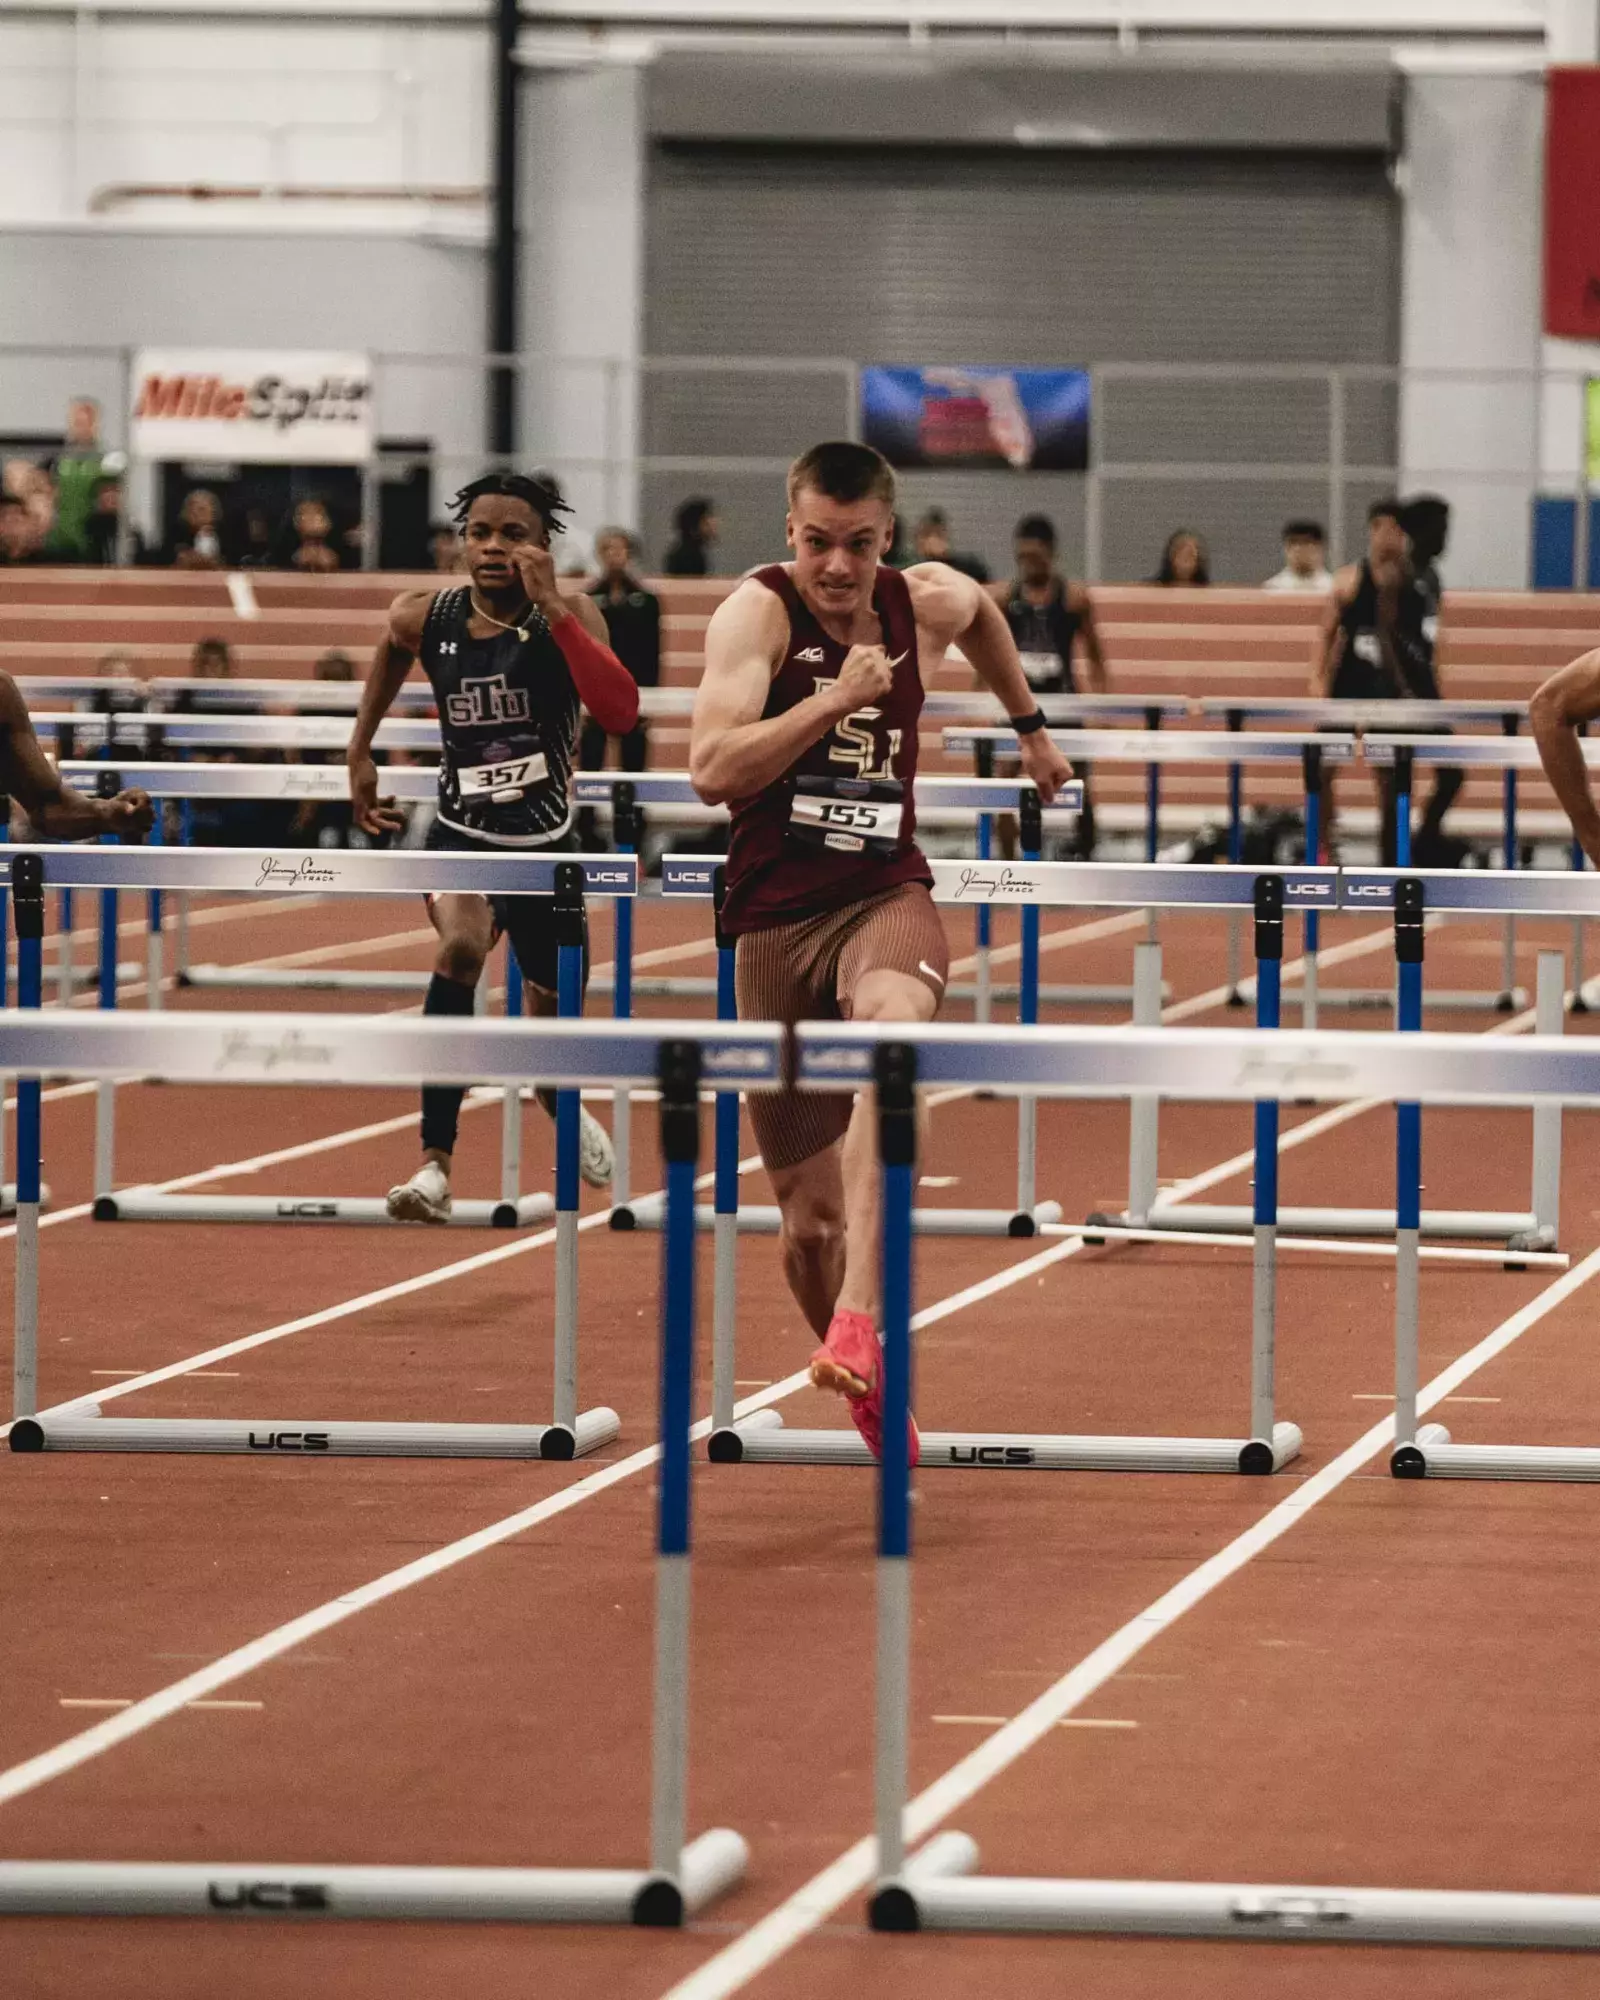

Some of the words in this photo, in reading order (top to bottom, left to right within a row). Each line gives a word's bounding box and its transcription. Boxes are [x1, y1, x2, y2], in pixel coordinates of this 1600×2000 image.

[446, 673, 531, 727] STU
[477, 761, 530, 788] 357
[819, 803, 879, 829] 155
[586, 871, 630, 883] UCS
[667, 871, 711, 883] UCS
[1286, 883, 1331, 895] UCS
[1347, 885, 1393, 897] UCS
[277, 1202, 338, 1217] UCS
[247, 1431, 329, 1450] UCS
[949, 1446, 1035, 1465] UCS
[207, 1881, 327, 1911] UCS
